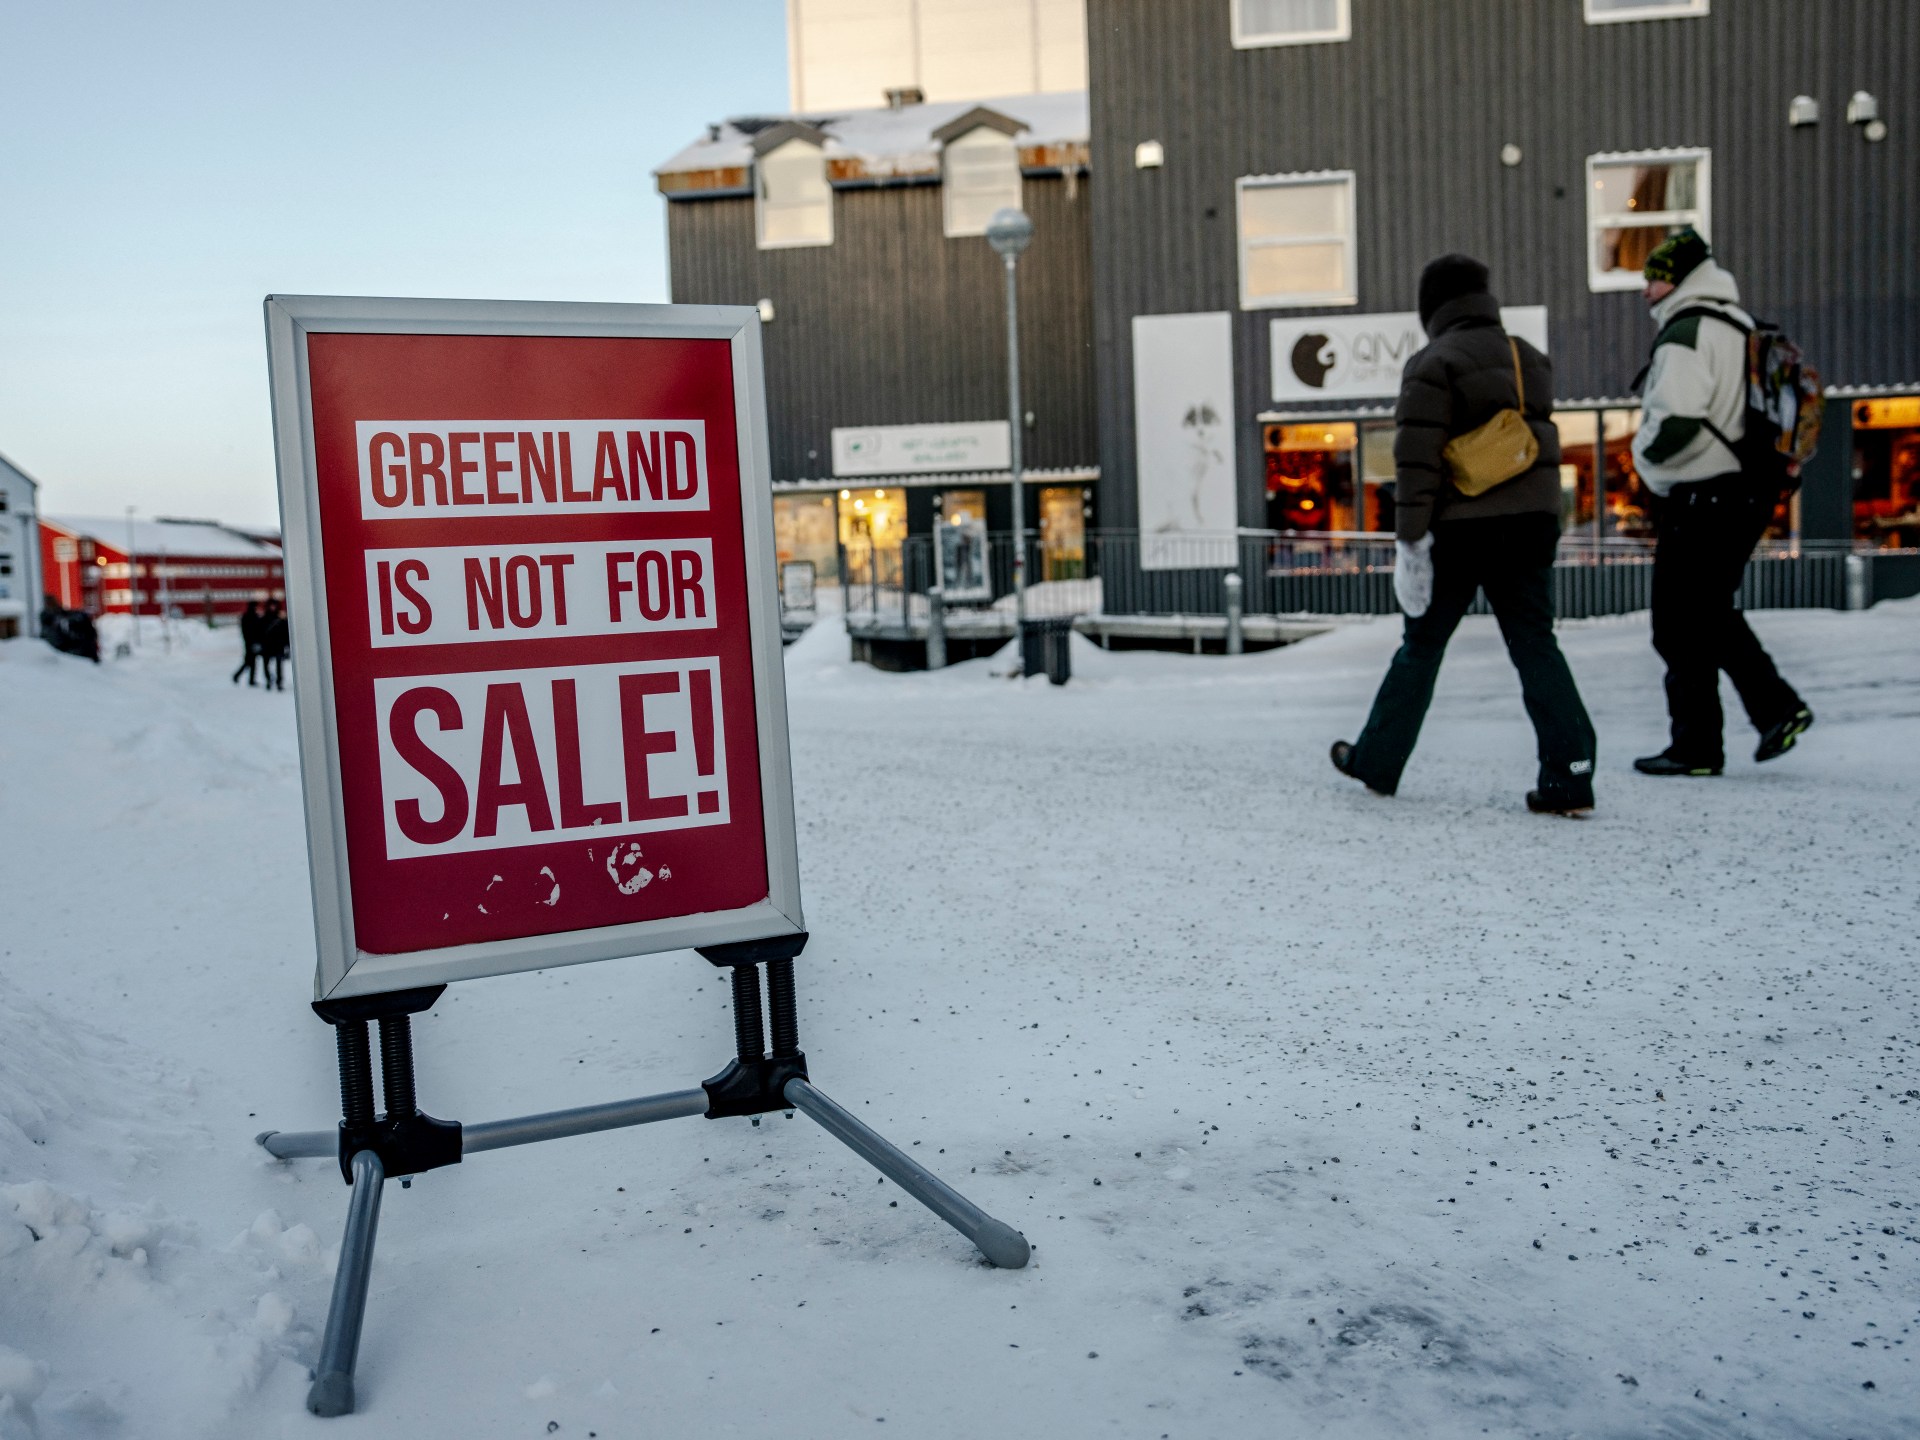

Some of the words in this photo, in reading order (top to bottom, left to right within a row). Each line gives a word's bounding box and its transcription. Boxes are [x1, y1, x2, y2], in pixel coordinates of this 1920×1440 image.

[368, 430, 699, 509] GREENLAND
[377, 558, 433, 636] IS
[463, 553, 575, 631] NOT
[606, 549, 707, 623] FOR
[388, 668, 720, 845] SALE!
